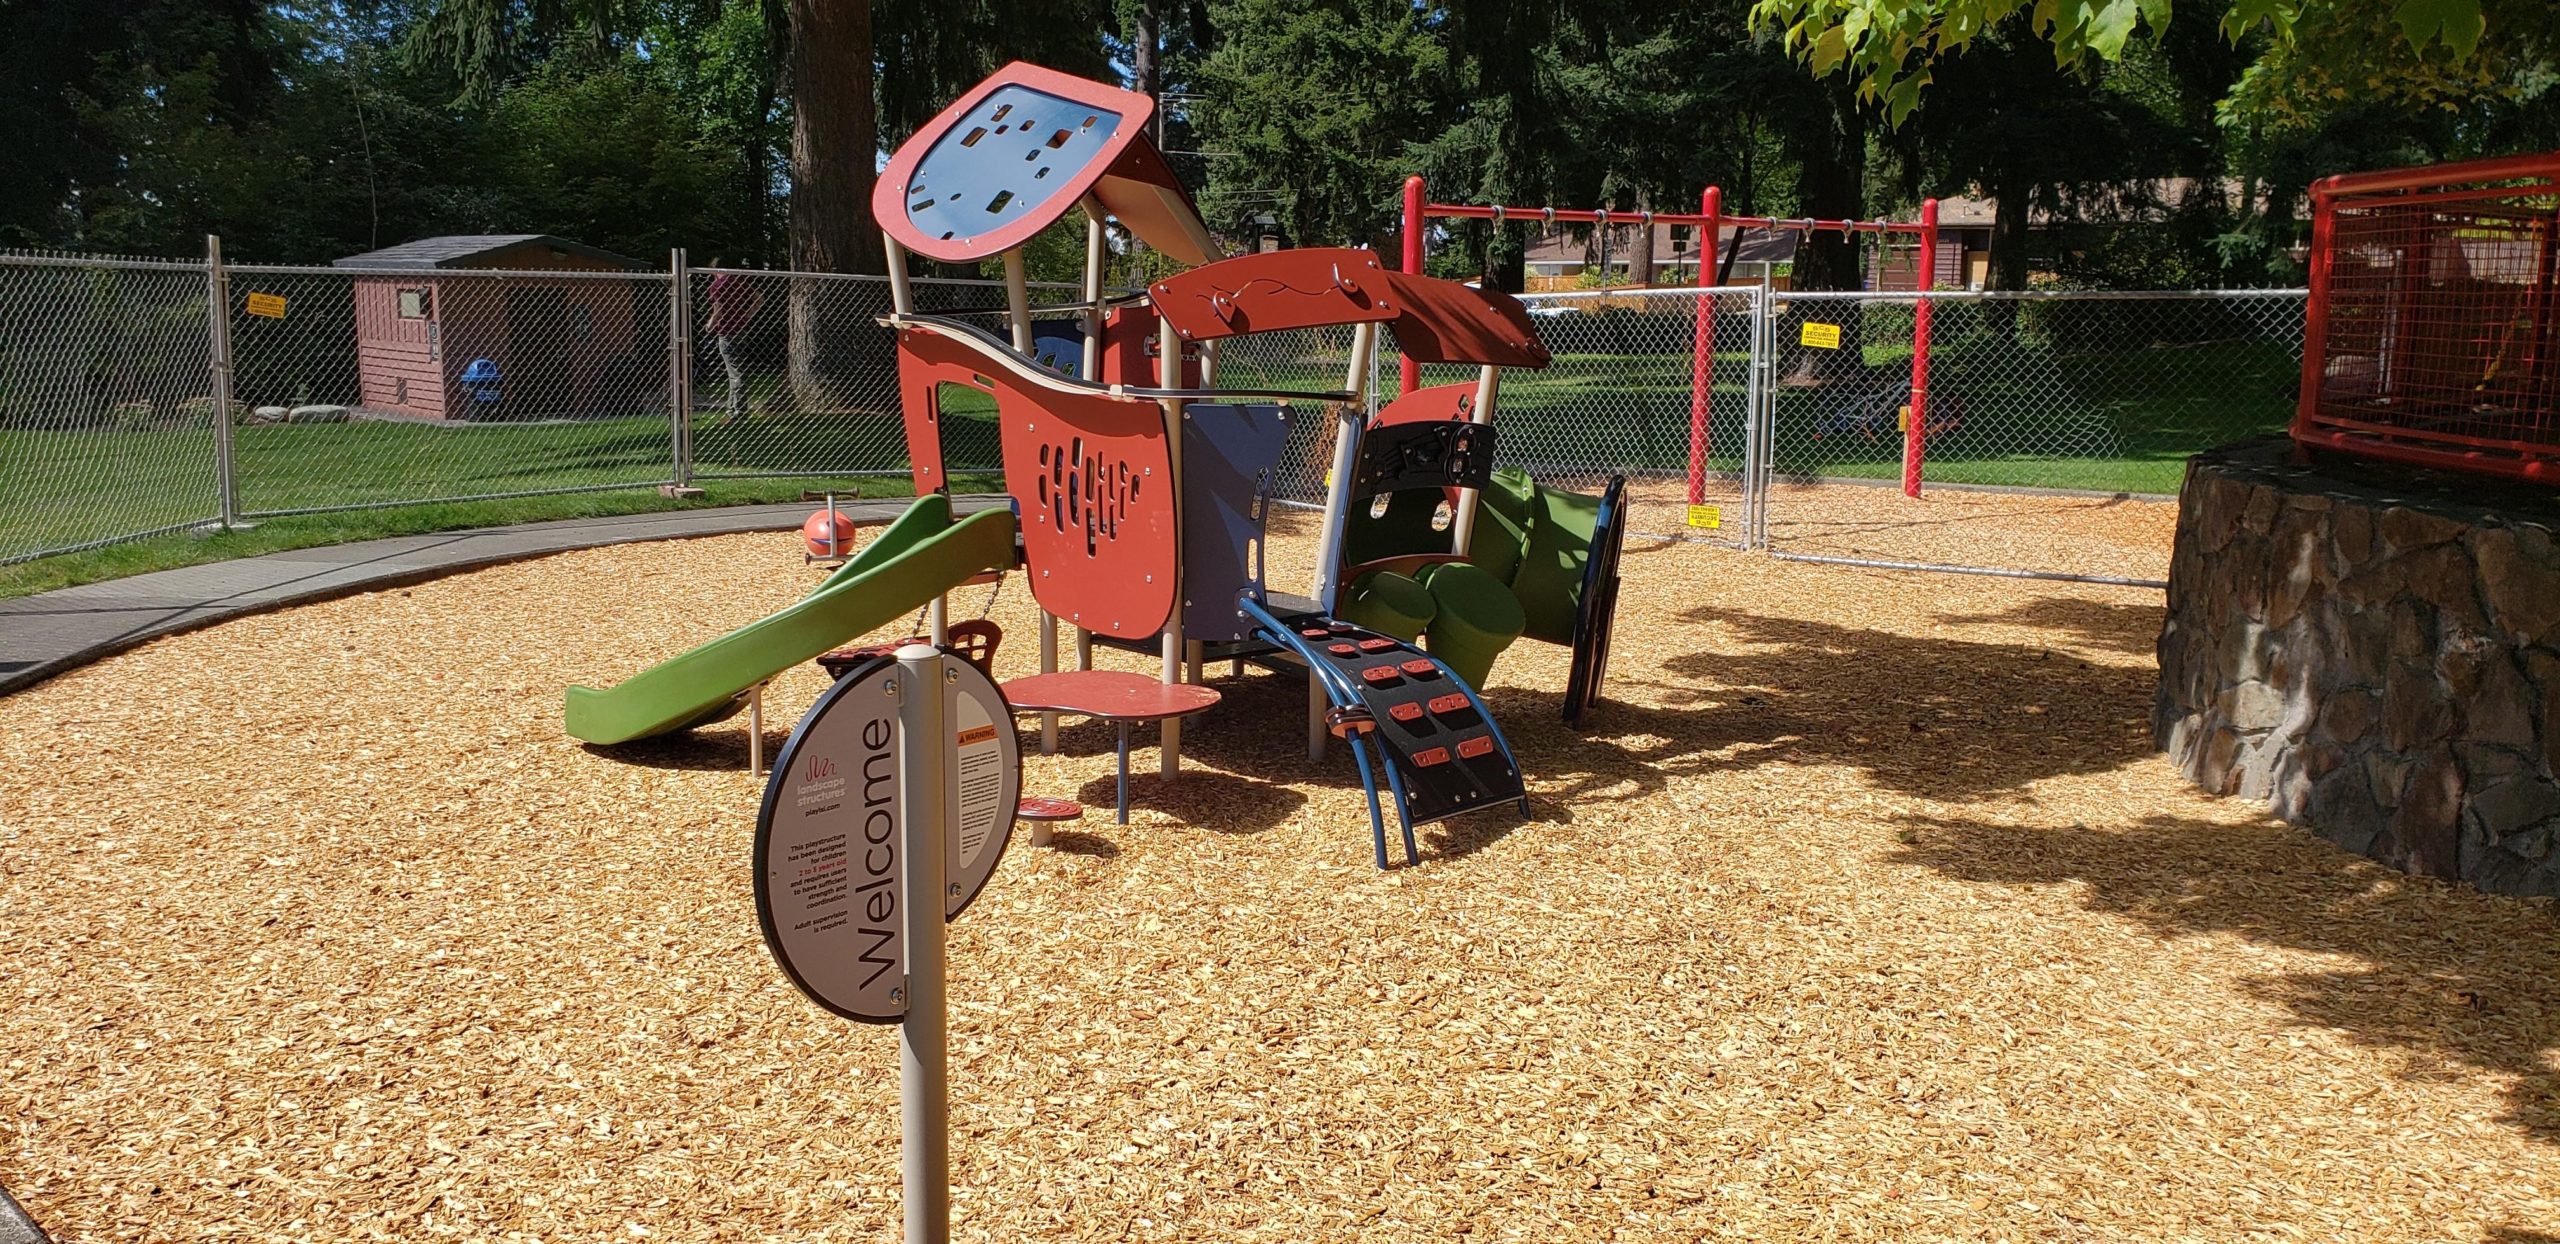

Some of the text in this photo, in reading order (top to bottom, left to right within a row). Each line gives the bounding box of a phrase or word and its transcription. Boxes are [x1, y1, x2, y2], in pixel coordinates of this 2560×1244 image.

[965, 728, 995, 742] WARNING
[797, 778, 845, 795] landscape
[796, 788, 846, 806] structures
[805, 804, 840, 817] playlsi.com
[790, 834, 846, 852] This playstructure
[800, 850, 816, 858] been
[818, 842, 846, 855] designed
[821, 851, 846, 861] children
[855, 717, 896, 992] Welcome
[818, 862, 835, 872] years
[836, 858, 847, 866] old
[790, 868, 847, 888] and requires users
[802, 884, 817, 893] have
[818, 876, 847, 888] sufficient
[808, 884, 847, 900] strength and
[806, 894, 848, 909] coordination.
[794, 910, 848, 931] Adult supervision
[820, 919, 848, 931] required.
